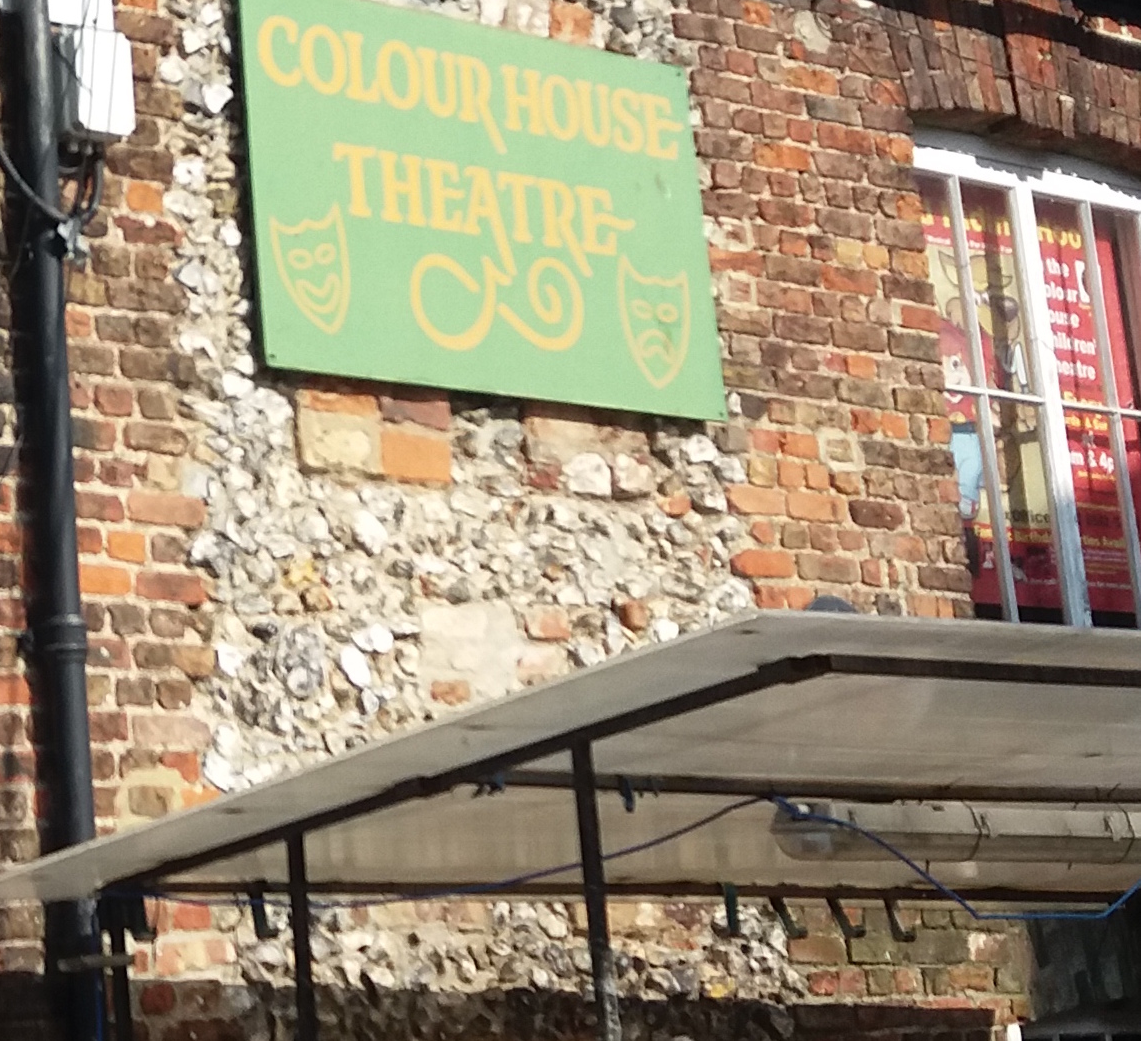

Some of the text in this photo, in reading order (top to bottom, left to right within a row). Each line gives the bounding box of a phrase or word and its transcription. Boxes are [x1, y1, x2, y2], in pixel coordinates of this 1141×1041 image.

[258, 14, 685, 160] COLOUR HOUSE
[332, 141, 636, 279] THEATRE
[1045, 280, 1079, 304] olour
[1048, 308, 1081, 329] ouse
